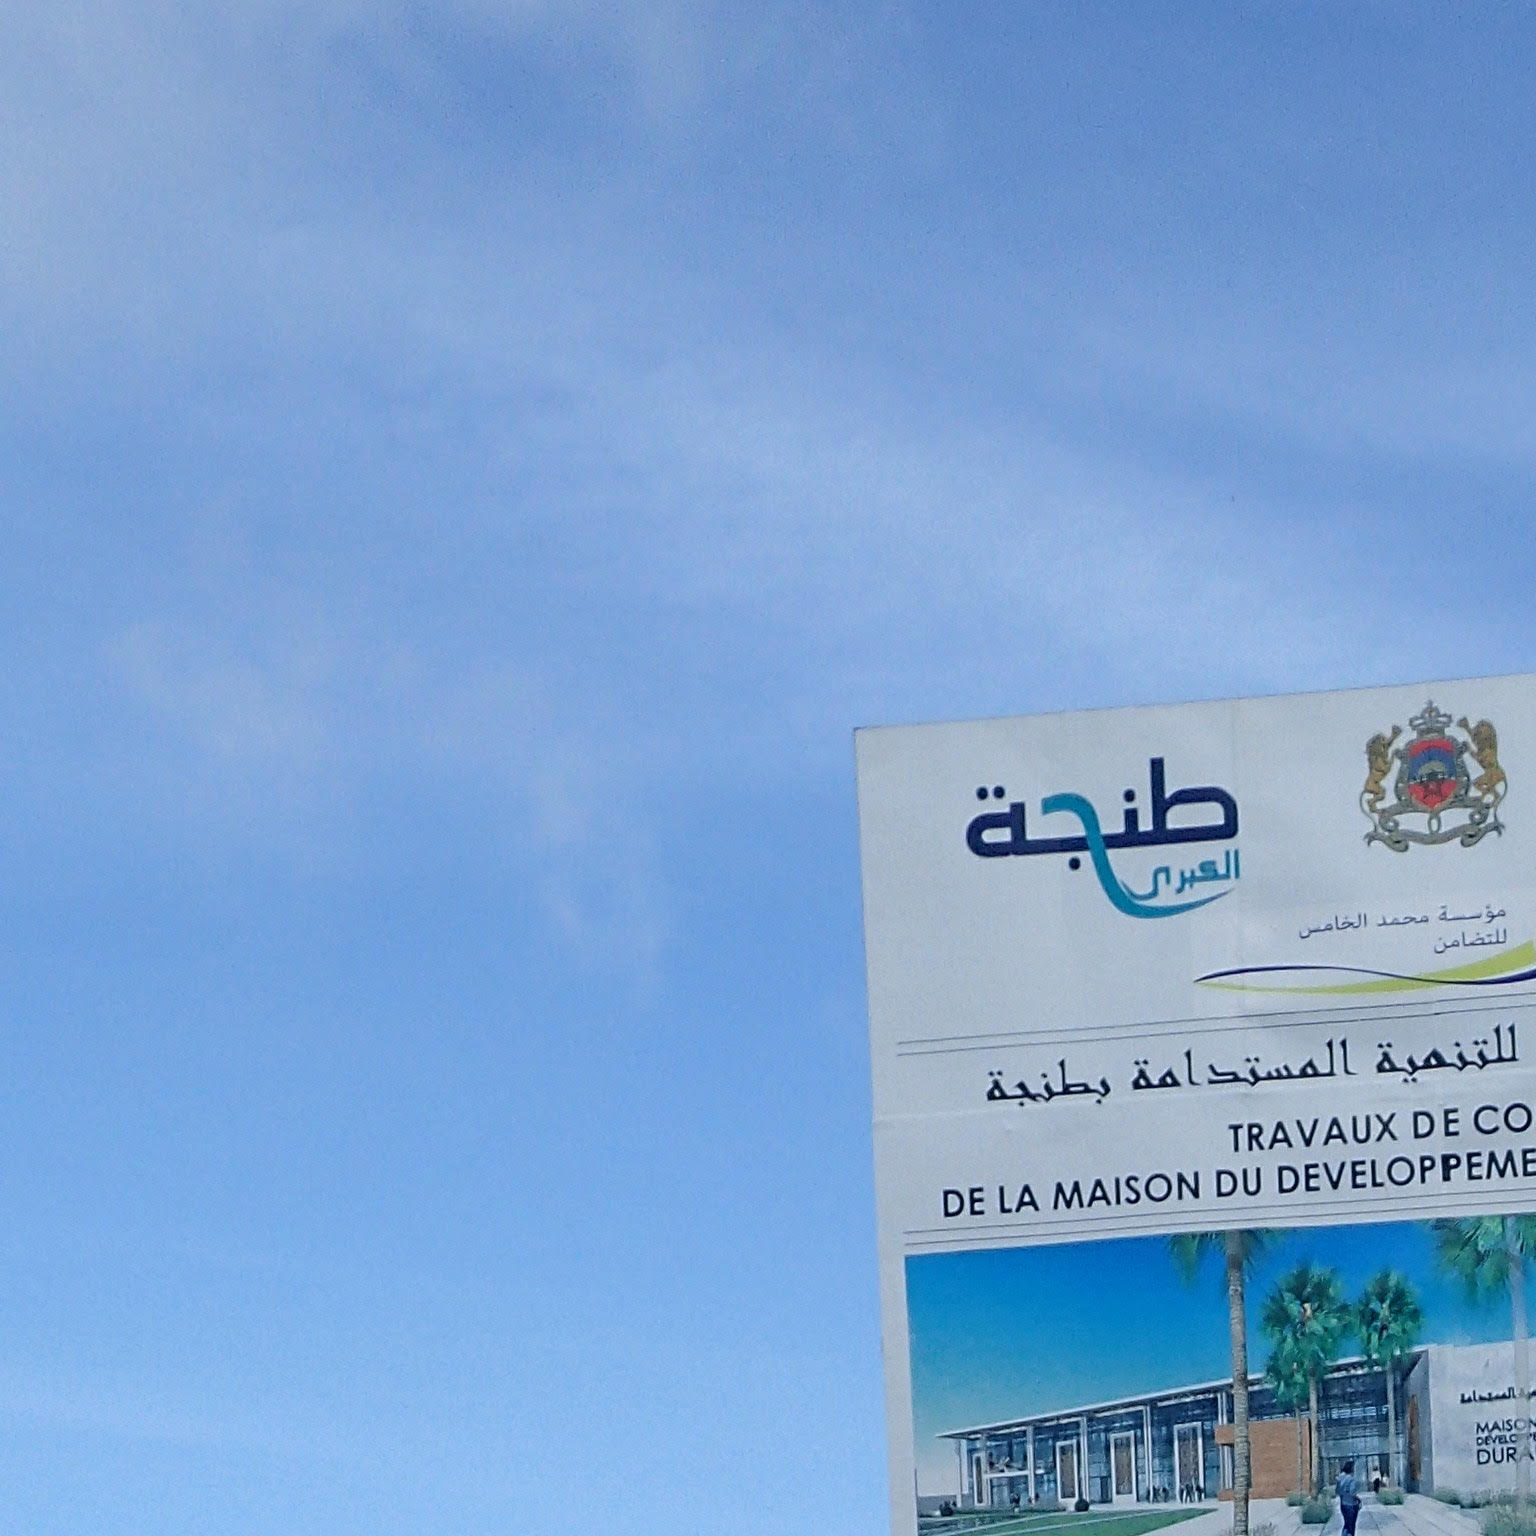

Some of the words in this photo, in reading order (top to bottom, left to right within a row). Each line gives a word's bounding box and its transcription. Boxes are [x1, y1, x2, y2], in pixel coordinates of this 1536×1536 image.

[966, 757, 1238, 905] طنجة
[1299, 913, 1368, 940] الخامس
[1376, 911, 1429, 927] محمد
[1438, 904, 1506, 923] مؤسسة
[1433, 928, 1507, 955] للتضامن
[1131, 1037, 1358, 1091] المستدامة
[1375, 1022, 1520, 1082] للتنمية
[986, 1058, 1112, 1107] بطنجة
[1227, 1112, 1398, 1153] TRAVAUX
[1412, 1107, 1460, 1140] DE
[942, 1186, 986, 1218] DE
[998, 1183, 1040, 1214] LA
[1052, 1170, 1200, 1211] MAISON
[1215, 1166, 1262, 1198] DU
